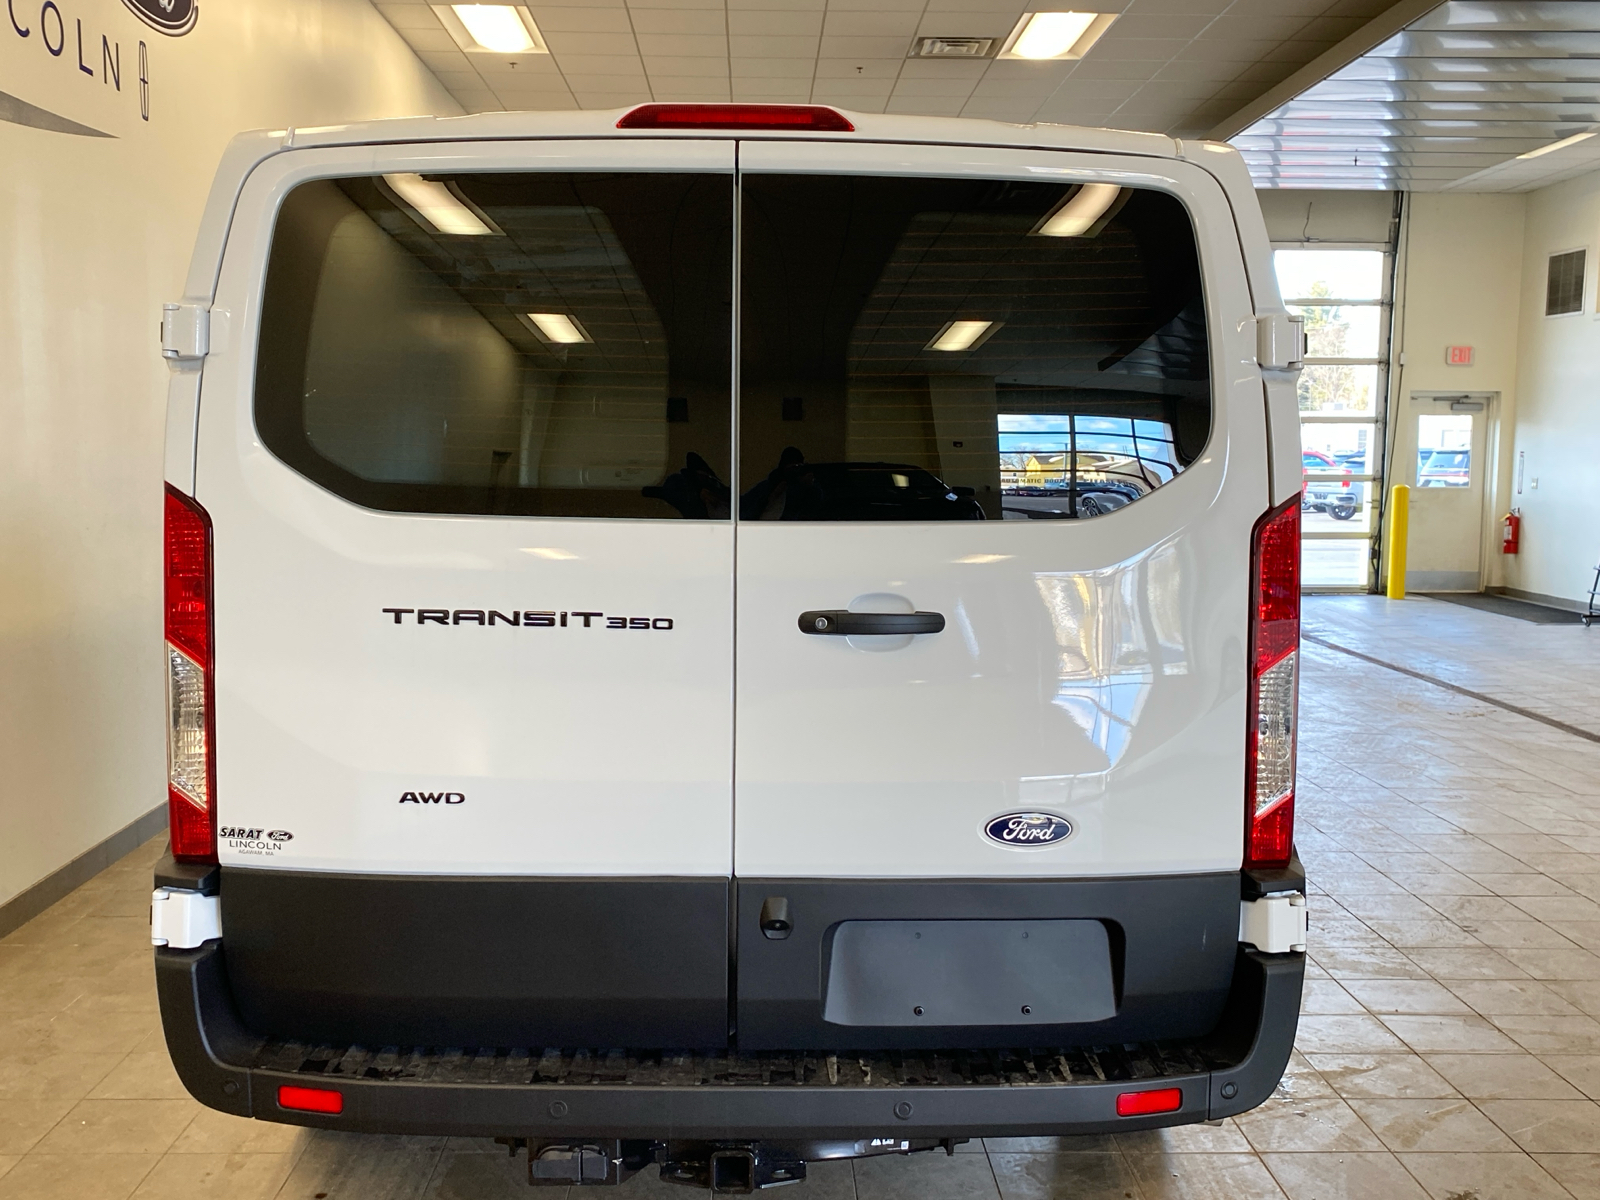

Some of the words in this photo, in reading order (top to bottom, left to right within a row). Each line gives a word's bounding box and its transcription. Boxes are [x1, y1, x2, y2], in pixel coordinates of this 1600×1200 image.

[1451, 346, 1472, 364] EXIT
[399, 791, 466, 804] AWD
[220, 827, 264, 840] SARAT
[1003, 818, 1056, 840] Ford
[229, 840, 282, 850] LINCOLN
